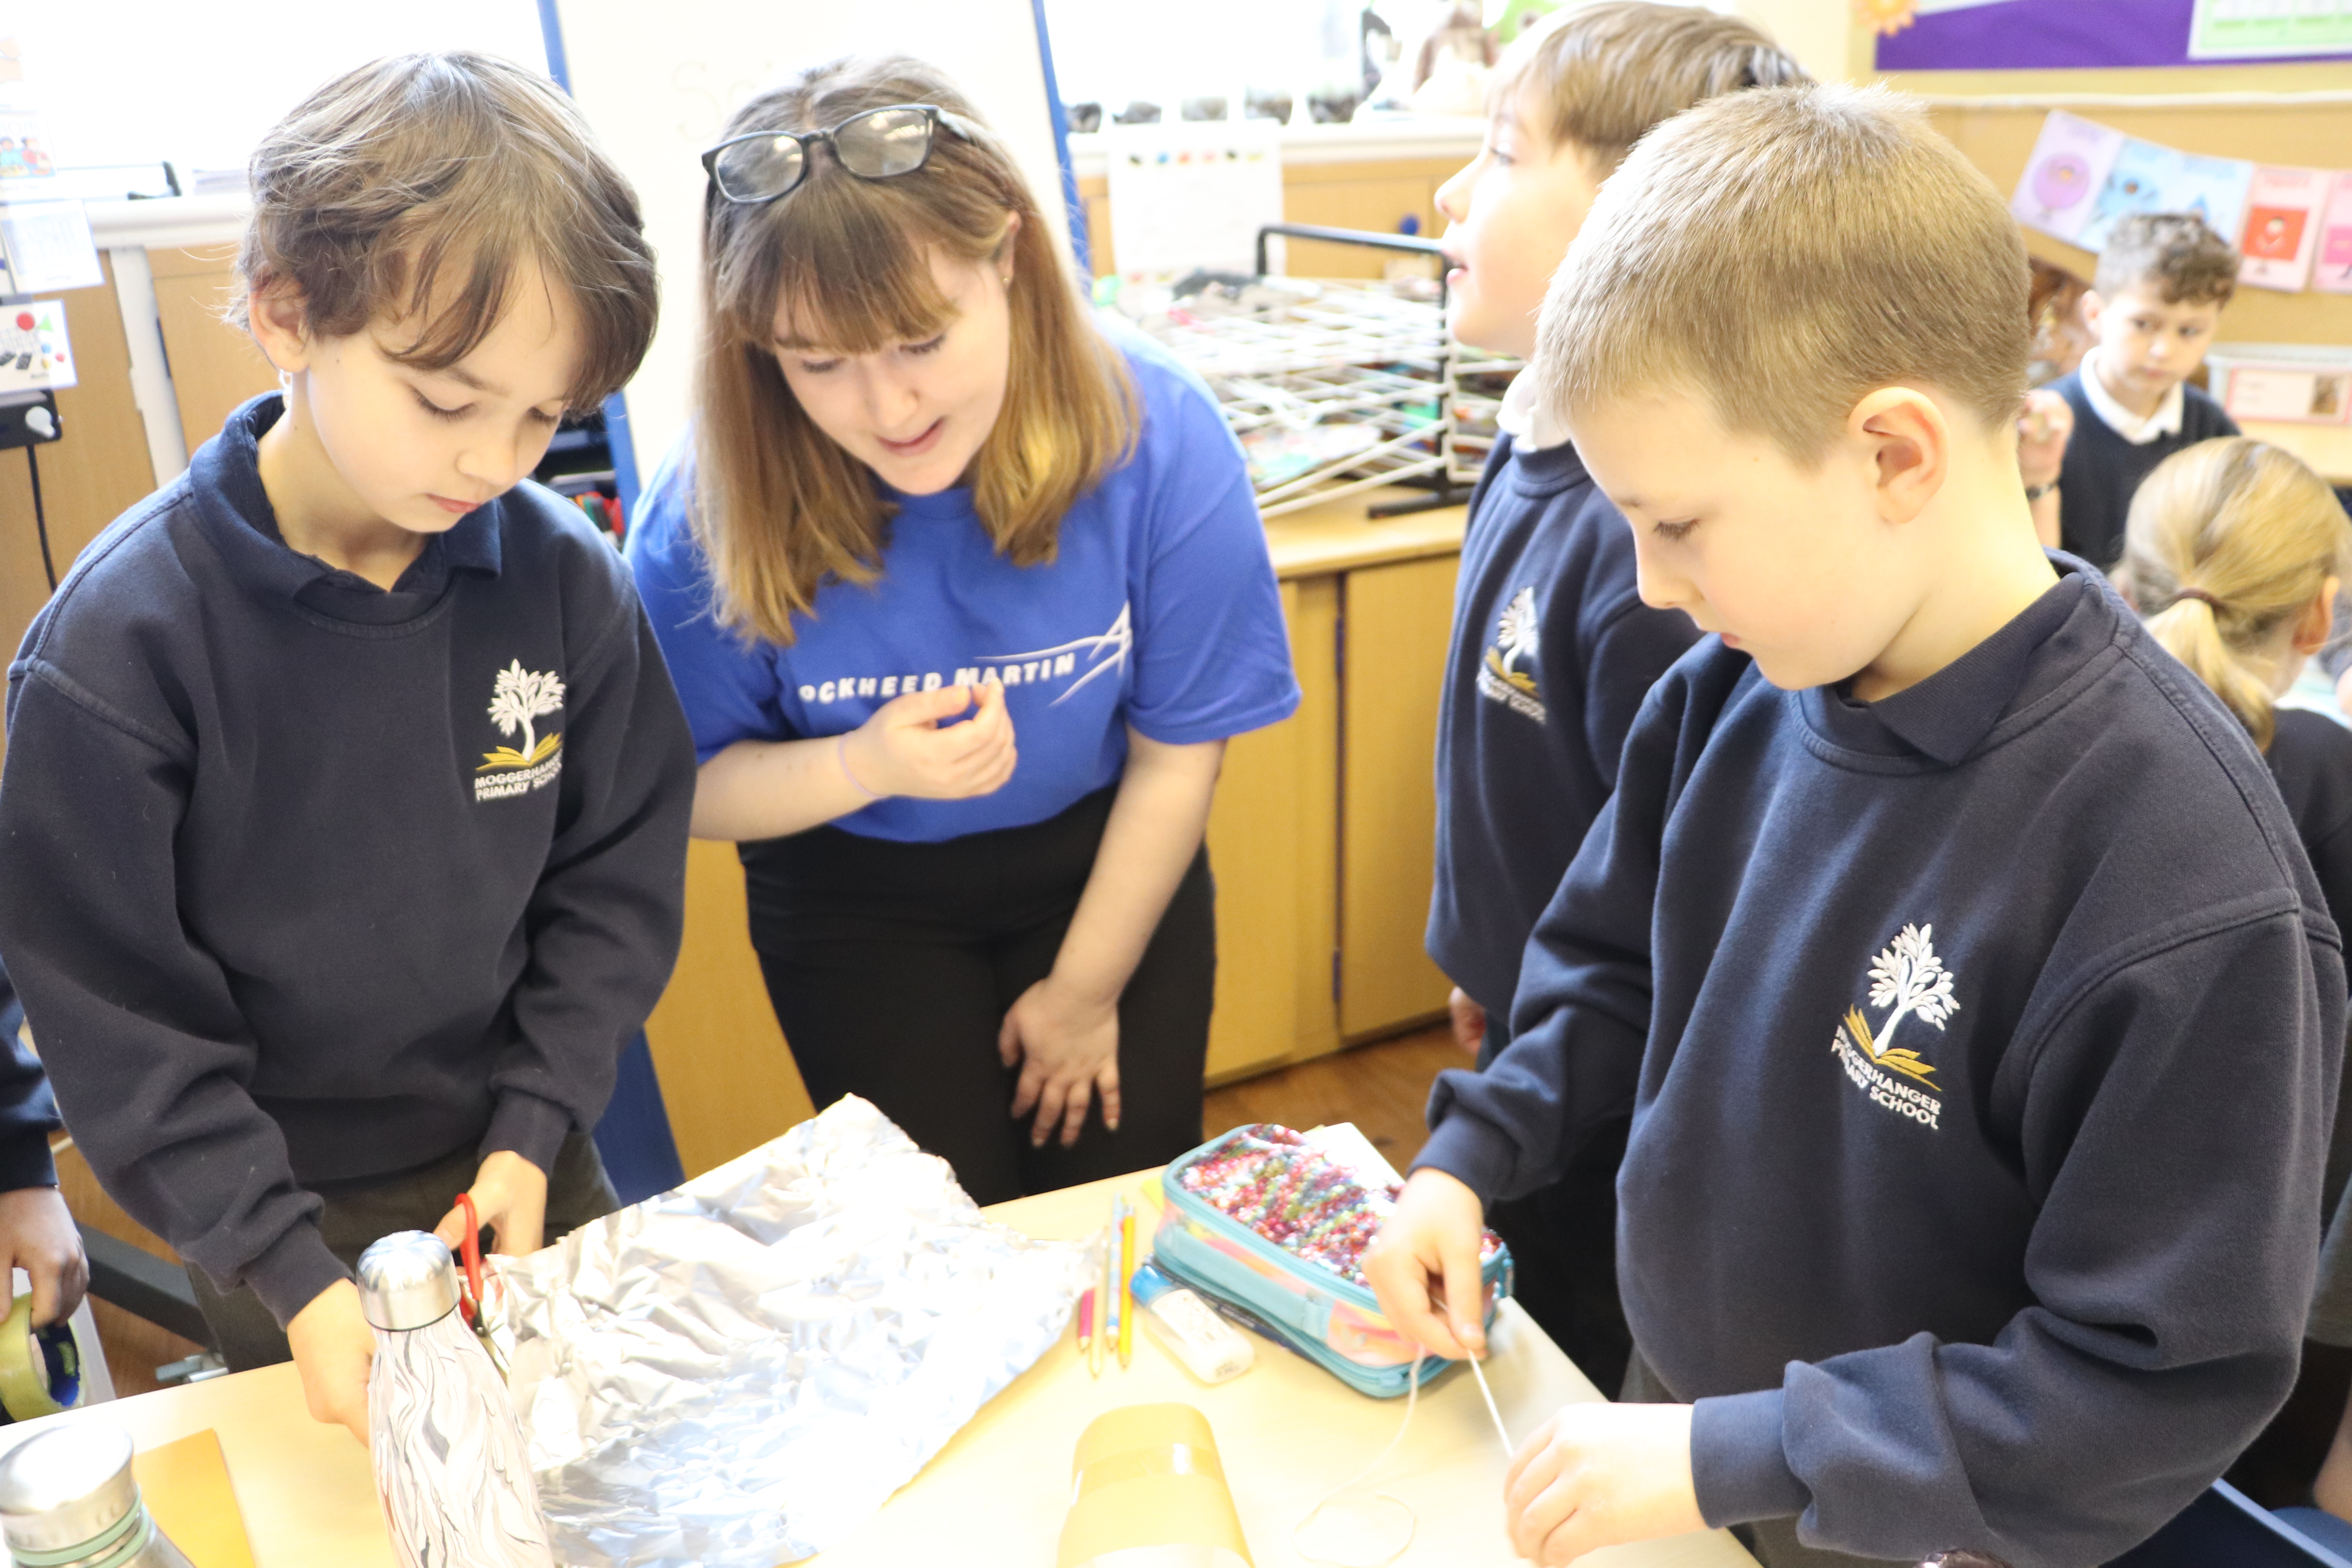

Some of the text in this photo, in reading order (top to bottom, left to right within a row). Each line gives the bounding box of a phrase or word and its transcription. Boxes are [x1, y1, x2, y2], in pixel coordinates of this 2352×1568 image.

[798, 652, 1076, 704] OCKHEED MARTIN
[475, 781, 530, 801] PRIMARY
[1869, 1085, 1938, 1130] SCHOOL
